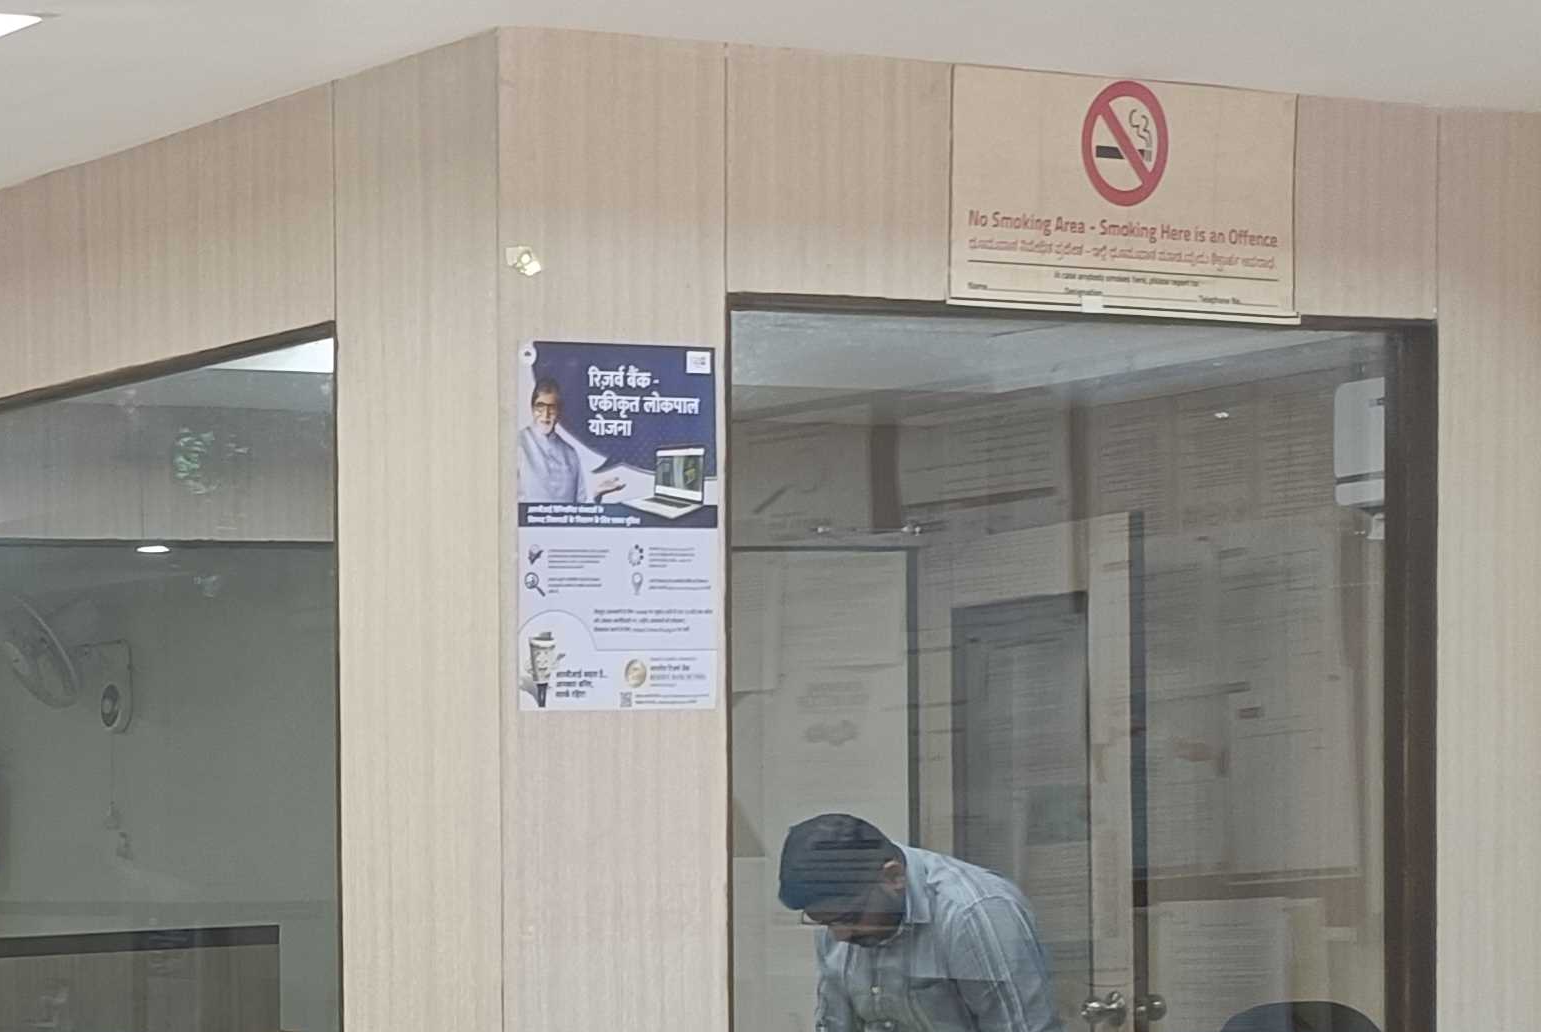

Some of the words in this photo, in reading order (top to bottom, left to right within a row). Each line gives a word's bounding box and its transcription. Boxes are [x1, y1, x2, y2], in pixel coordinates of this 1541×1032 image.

[968, 209, 988, 227] No
[991, 211, 1052, 237] Smoking
[1055, 215, 1086, 234] Area
[1099, 218, 1157, 244] Smoking
[1160, 223, 1192, 242] Here
[1194, 224, 1206, 243] is
[1209, 230, 1226, 244] an
[1228, 227, 1278, 248] Offence
[587, 365, 625, 390] रिज़र्व
[626, 365, 652, 389] बैंक
[587, 390, 641, 417] एकीकृत
[642, 391, 700, 415] लोकपाल
[587, 414, 633, 437] योजना
